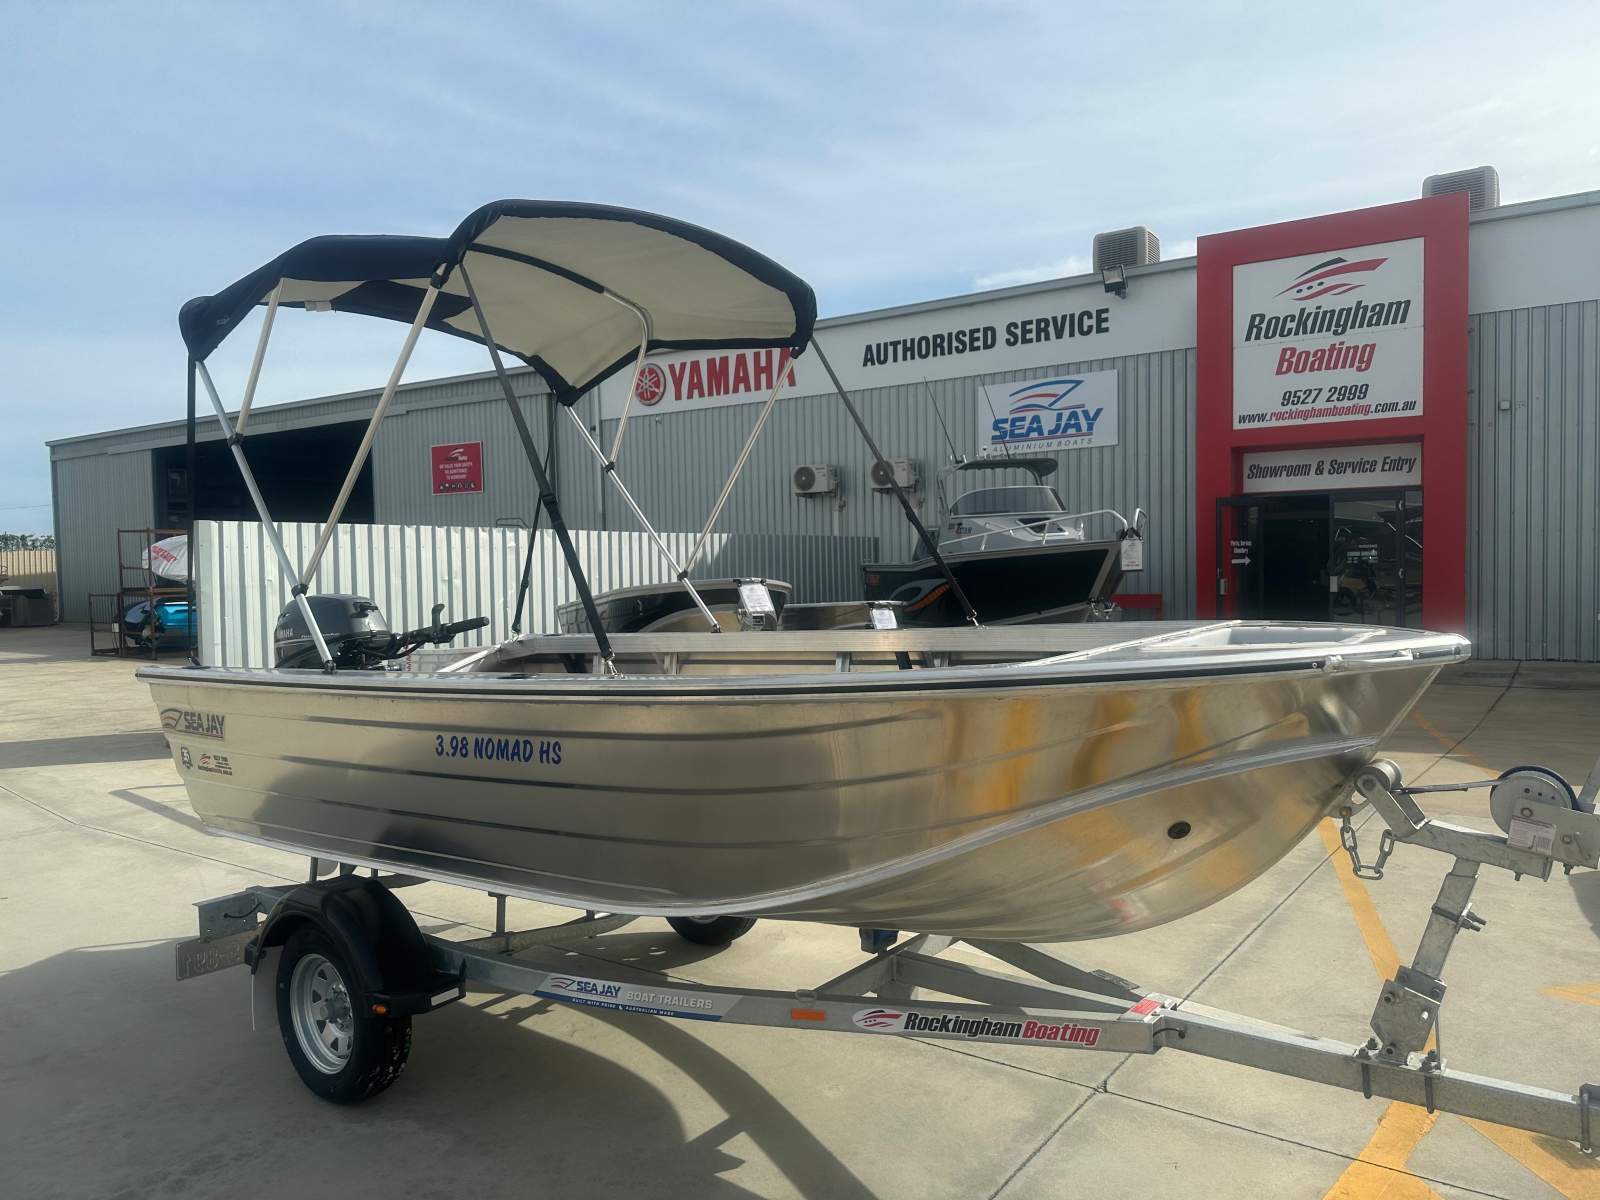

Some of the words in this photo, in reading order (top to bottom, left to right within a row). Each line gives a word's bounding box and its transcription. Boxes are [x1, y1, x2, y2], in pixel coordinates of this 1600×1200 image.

[1245, 299, 1411, 342] Rockingham
[862, 326, 996, 367] AUTHORISED
[1005, 308, 1110, 347] SERVICE
[1275, 341, 1377, 376] Boating
[668, 347, 797, 401] YAMAHA
[1281, 388, 1323, 407] 9527
[1325, 383, 1370, 403] 2999
[991, 414, 1045, 441] SEA
[1048, 407, 1104, 436] JAY
[1238, 400, 1417, 424] www.rockinghamboating.com.au
[1056, 437, 1095, 448] BOATS
[1247, 463, 1312, 480] Showroom
[1314, 460, 1325, 476] &
[1327, 458, 1378, 475] Service
[1380, 455, 1417, 474] Entry
[183, 711, 205, 732] SEA
[206, 713, 225, 735] JAY
[435, 734, 469, 758] 3.98
[473, 737, 534, 763] NOMAD
[539, 740, 562, 765] HS
[576, 980, 598, 994] SEA
[600, 984, 622, 997] JAY
[626, 990, 656, 1002] BOAT
[657, 993, 713, 1010] TRAILERS
[903, 1012, 1023, 1038] Rockingham
[1022, 1020, 1100, 1046] Boating
